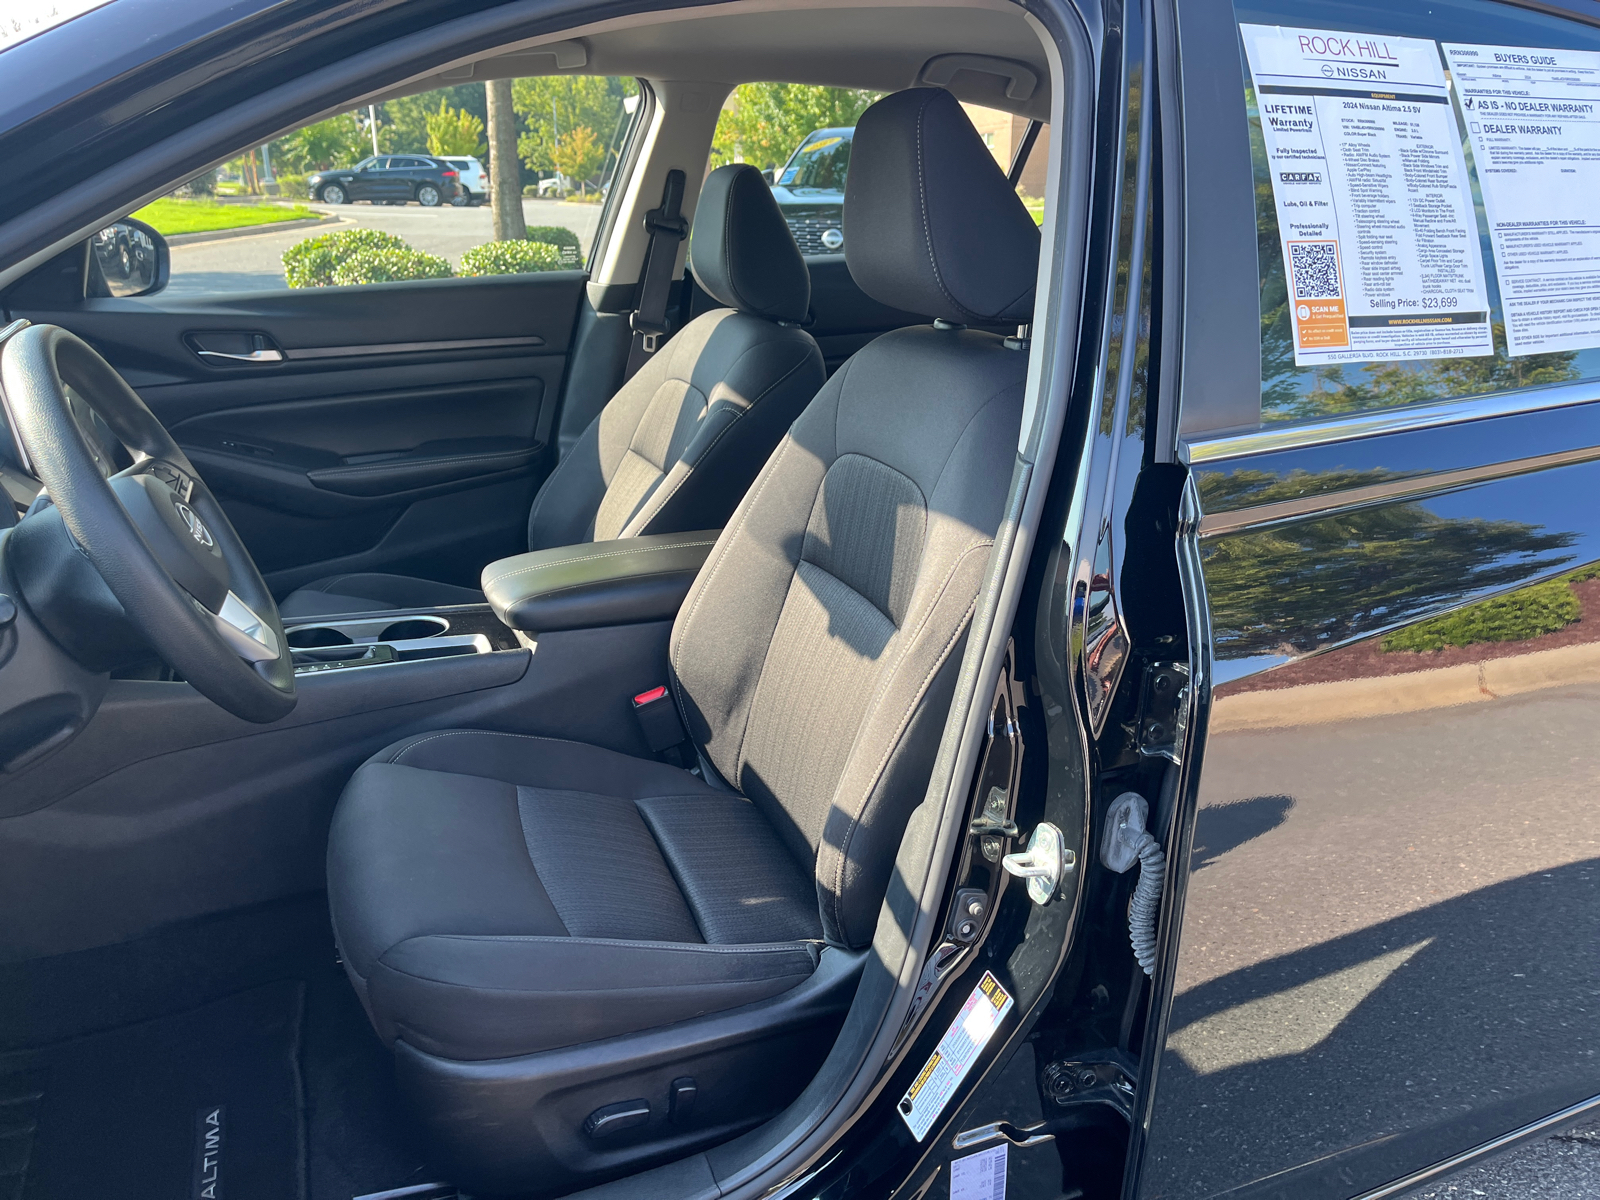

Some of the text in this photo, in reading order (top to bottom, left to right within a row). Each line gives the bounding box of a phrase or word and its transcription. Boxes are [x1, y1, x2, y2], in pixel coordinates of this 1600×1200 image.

[1298, 35, 1397, 59] ROCK HILL
[1494, 53, 1557, 66] BUYERS GUIDE
[1337, 67, 1386, 79] NISSAN
[1265, 104, 1313, 114] LIFETIME
[1382, 104, 1401, 112] Altima
[1478, 100, 1489, 109] AS
[1490, 101, 1499, 109] IS
[1505, 102, 1517, 110] NO
[1518, 102, 1550, 111] DEALER
[1550, 103, 1593, 113] WARRANTY
[1268, 117, 1313, 128] Warranty
[1483, 124, 1562, 135] DEALER WARRANTY
[1280, 173, 1322, 182] CARFAX
[1370, 297, 1458, 309] Selling Price: $23,699
[194, 516, 204, 542] NIS
[201, 1108, 220, 1199] ALTIMA
